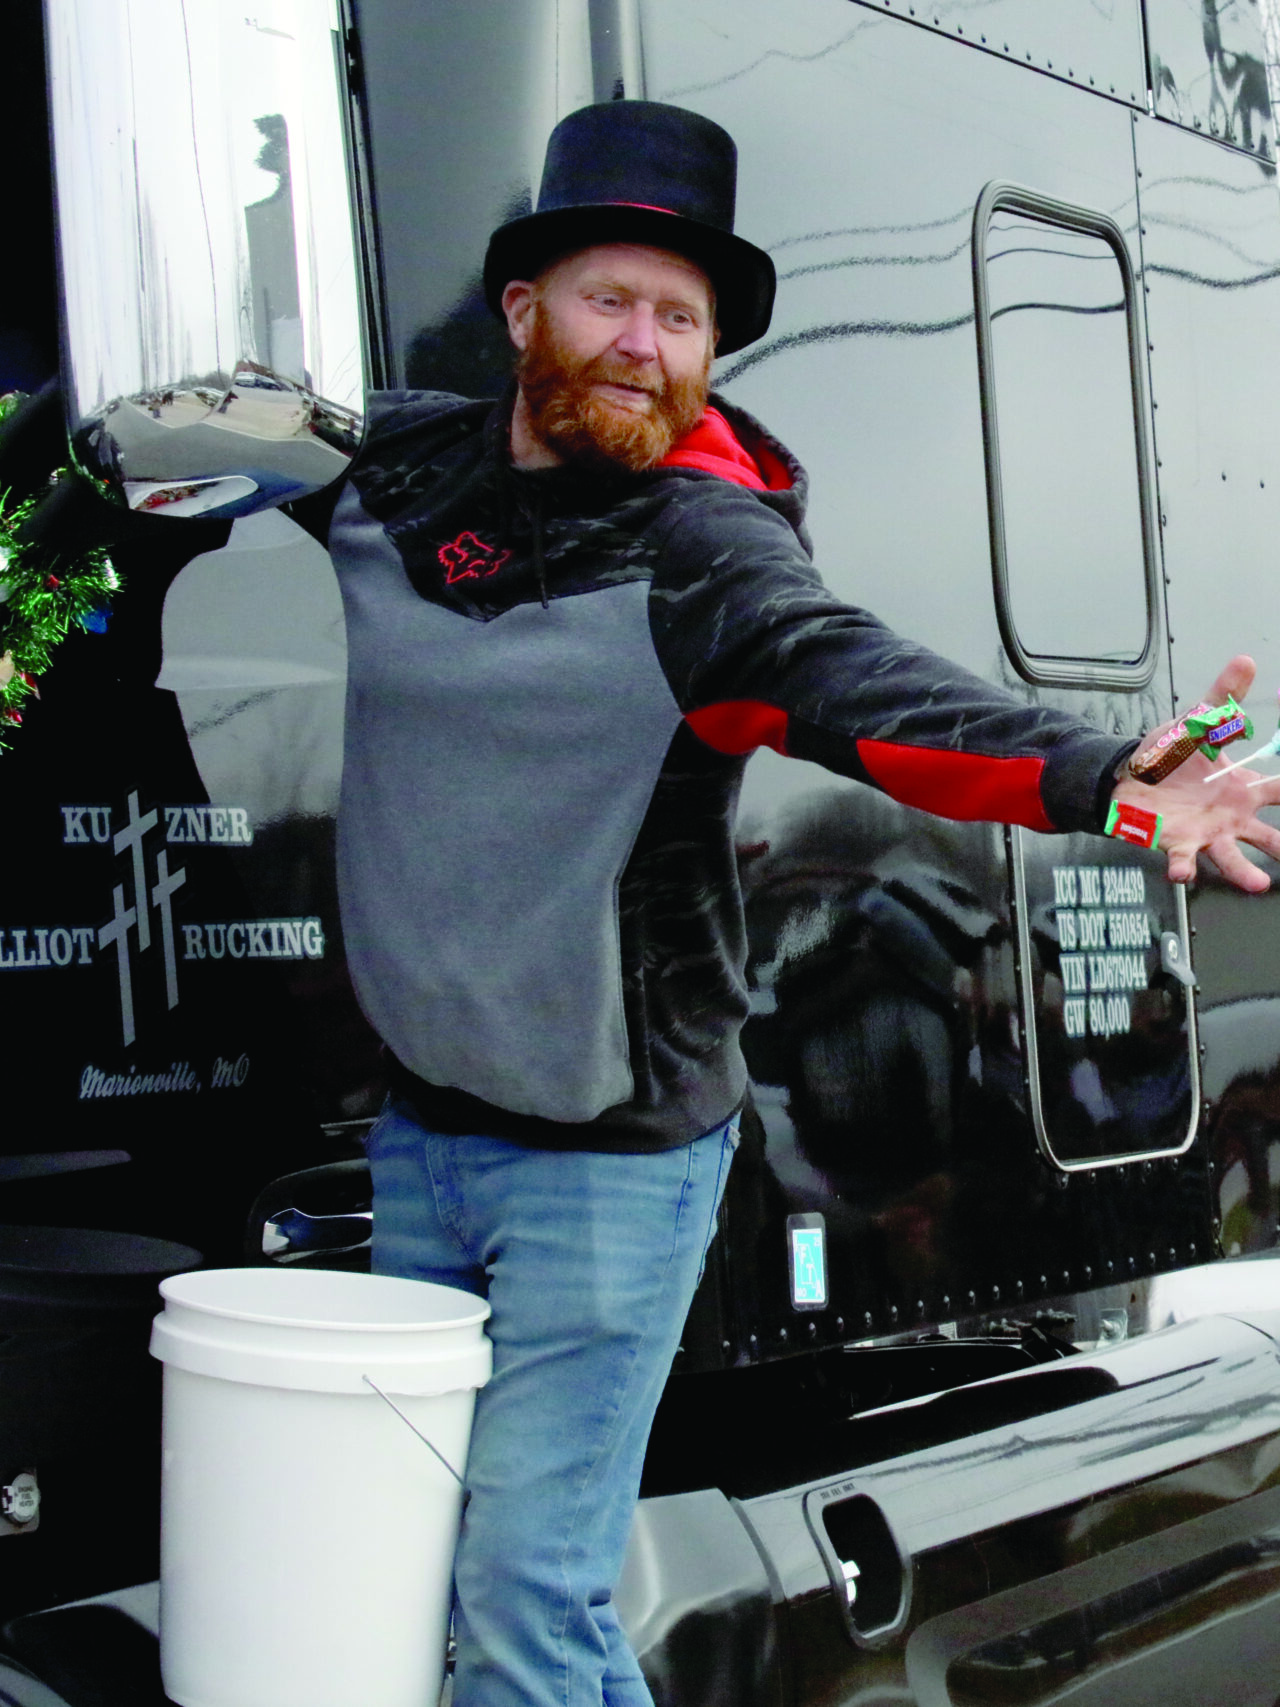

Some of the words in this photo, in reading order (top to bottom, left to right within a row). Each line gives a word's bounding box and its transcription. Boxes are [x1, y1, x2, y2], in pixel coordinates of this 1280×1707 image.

[1210, 718, 1244, 744] SNICKERS
[1053, 869, 1077, 905] ICC
[1079, 869, 1100, 905] MC
[1103, 867, 1145, 904] 234439
[1056, 912, 1077, 950] US
[1079, 912, 1106, 949] DOT
[1109, 912, 1151, 949] 550854
[1059, 955, 1087, 993] VIN
[1064, 999, 1087, 1036] GW
[1089, 996, 1131, 1040] 80,000
[79, 1062, 201, 1099] Marionville,
